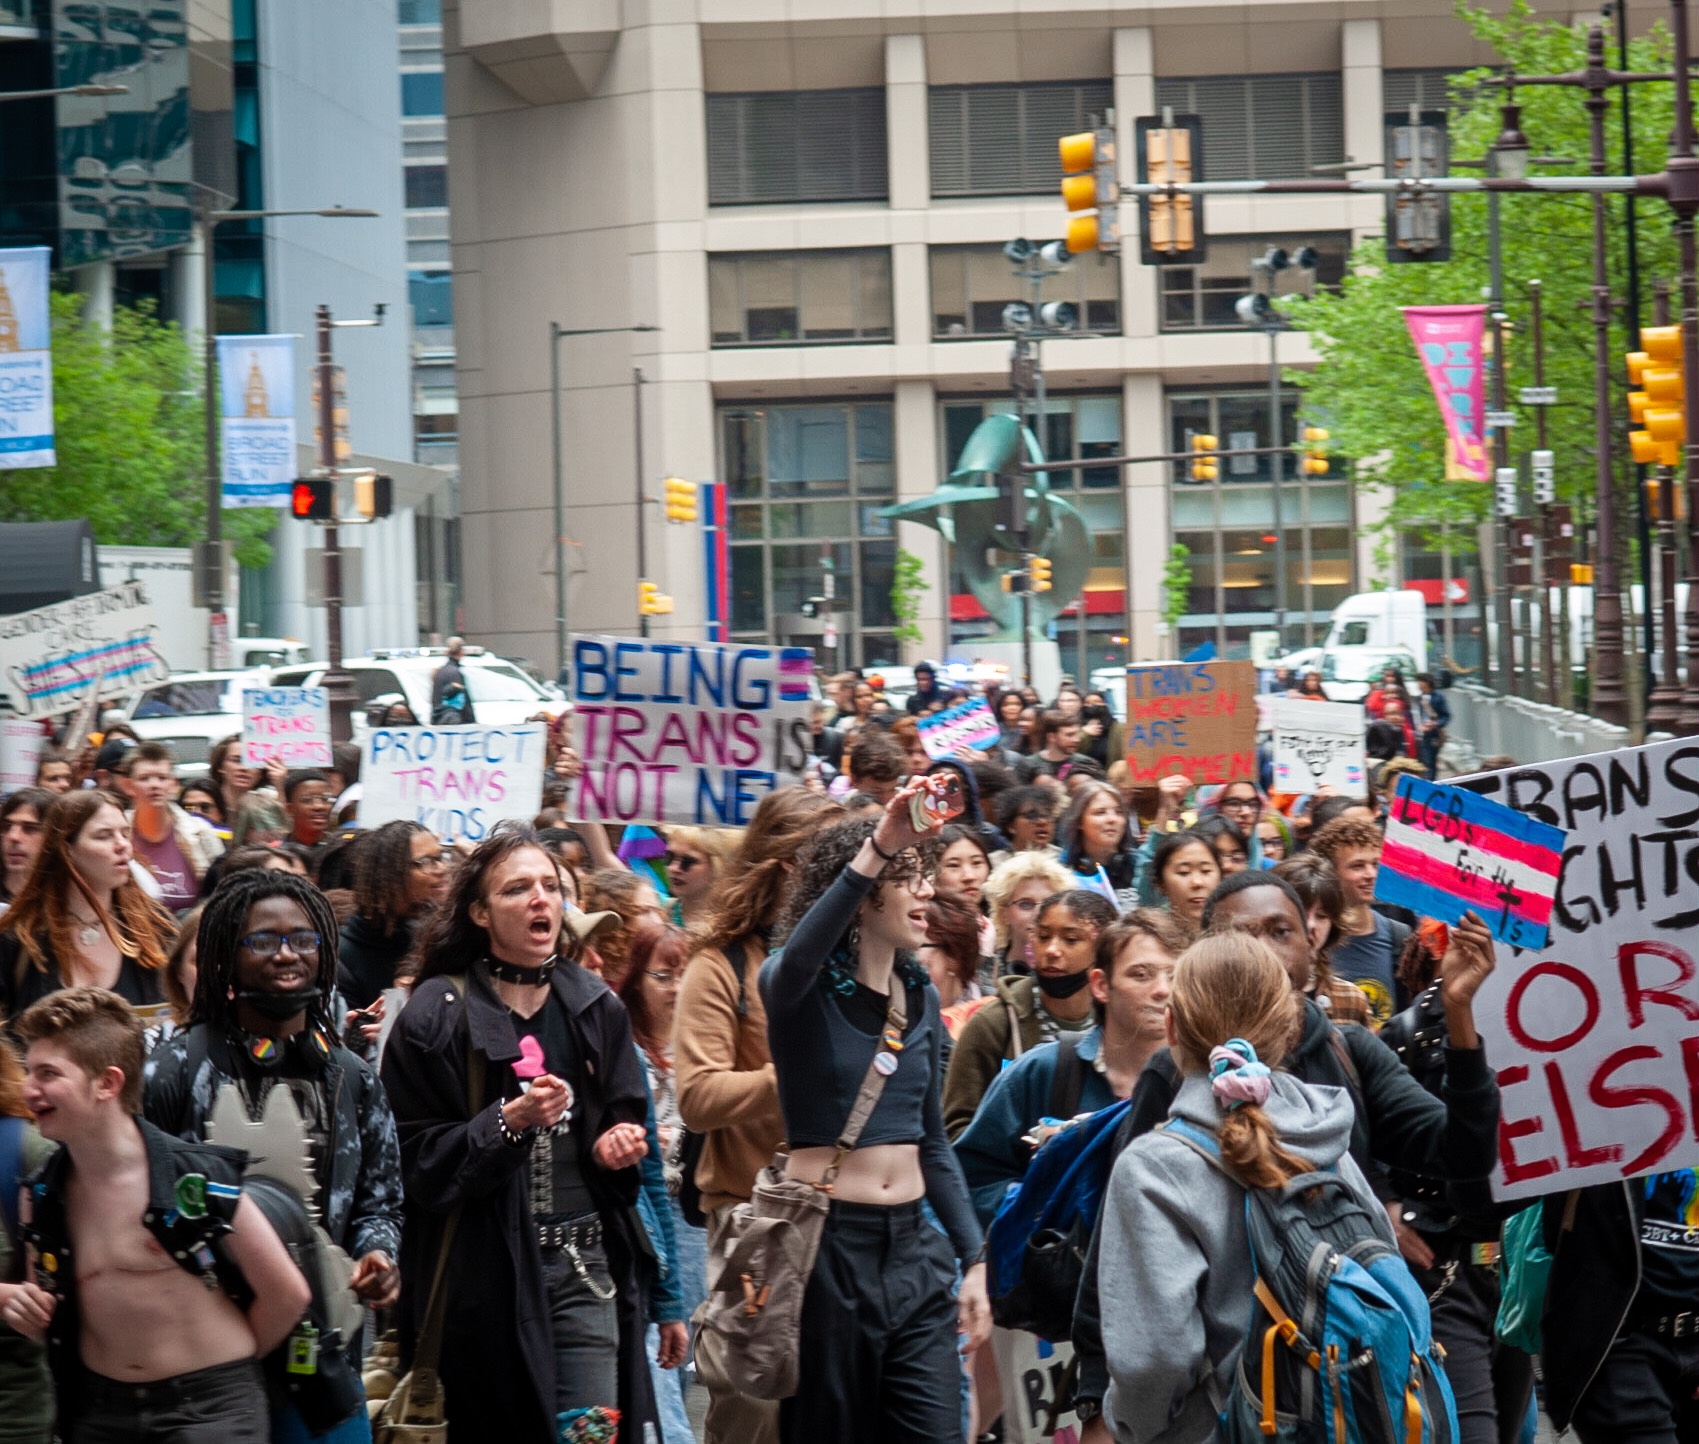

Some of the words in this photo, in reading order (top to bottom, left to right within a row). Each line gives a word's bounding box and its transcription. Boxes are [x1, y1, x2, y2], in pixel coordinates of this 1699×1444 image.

[227, 436, 290, 450] BROAD
[228, 468, 270, 481] RUN
[574, 639, 771, 710] BEING
[1126, 664, 1216, 698] TRANS
[1129, 688, 1240, 718] WOMEN
[249, 714, 317, 736] TRANS
[574, 705, 763, 768] TRANS
[773, 718, 809, 772] IS
[1128, 720, 1189, 748] ARE
[371, 730, 539, 765] PROTECT
[391, 766, 508, 802] TRANS
[1126, 751, 1255, 784] WOMEN
[576, 762, 680, 822] NOT
[694, 767, 776, 826] NE
[416, 805, 487, 844] KIDS
[1454, 848, 1484, 887] For
[1505, 939, 1699, 1054] OR
